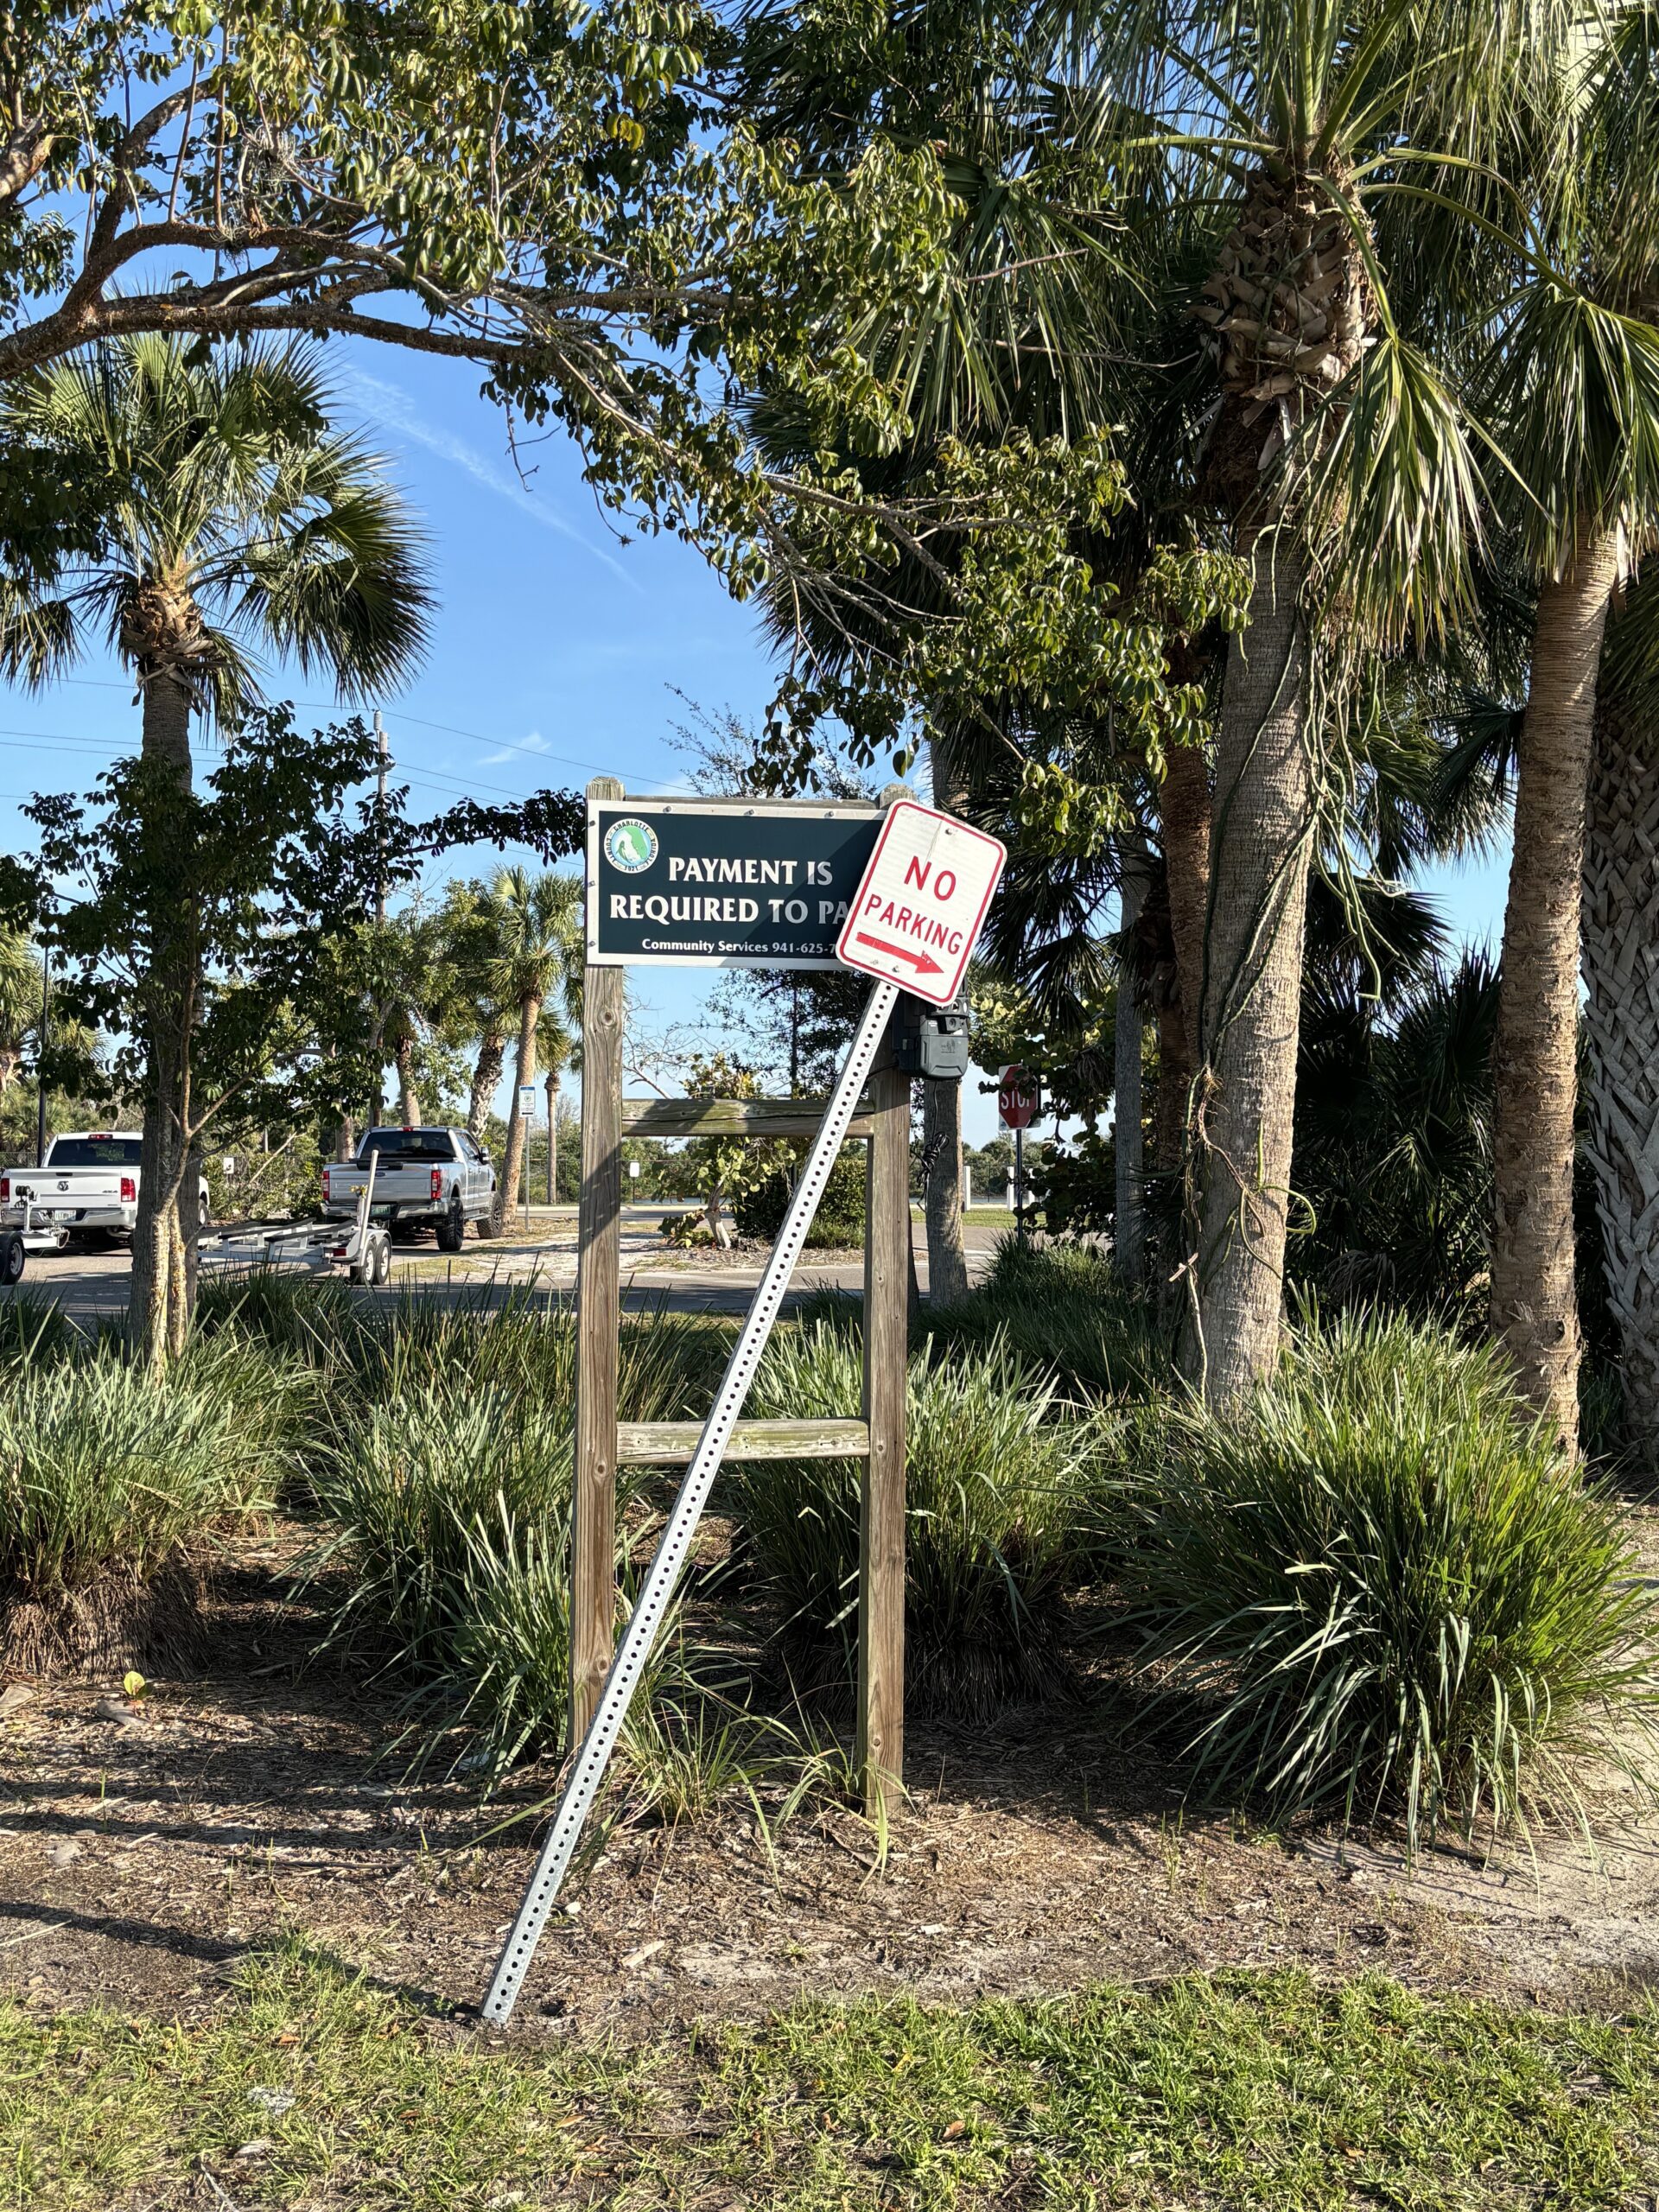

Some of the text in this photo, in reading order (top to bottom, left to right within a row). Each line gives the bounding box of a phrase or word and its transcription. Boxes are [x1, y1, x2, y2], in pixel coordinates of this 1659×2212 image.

[613, 820, 649, 832] CHARLOTTE
[669, 856, 833, 886] PAYMENT IS
[904, 855, 956, 901] NO
[610, 894, 849, 925] REQUIRED TO PA
[864, 893, 963, 955] PARKING
[641, 938, 836, 954] Community Services 941-625-7
